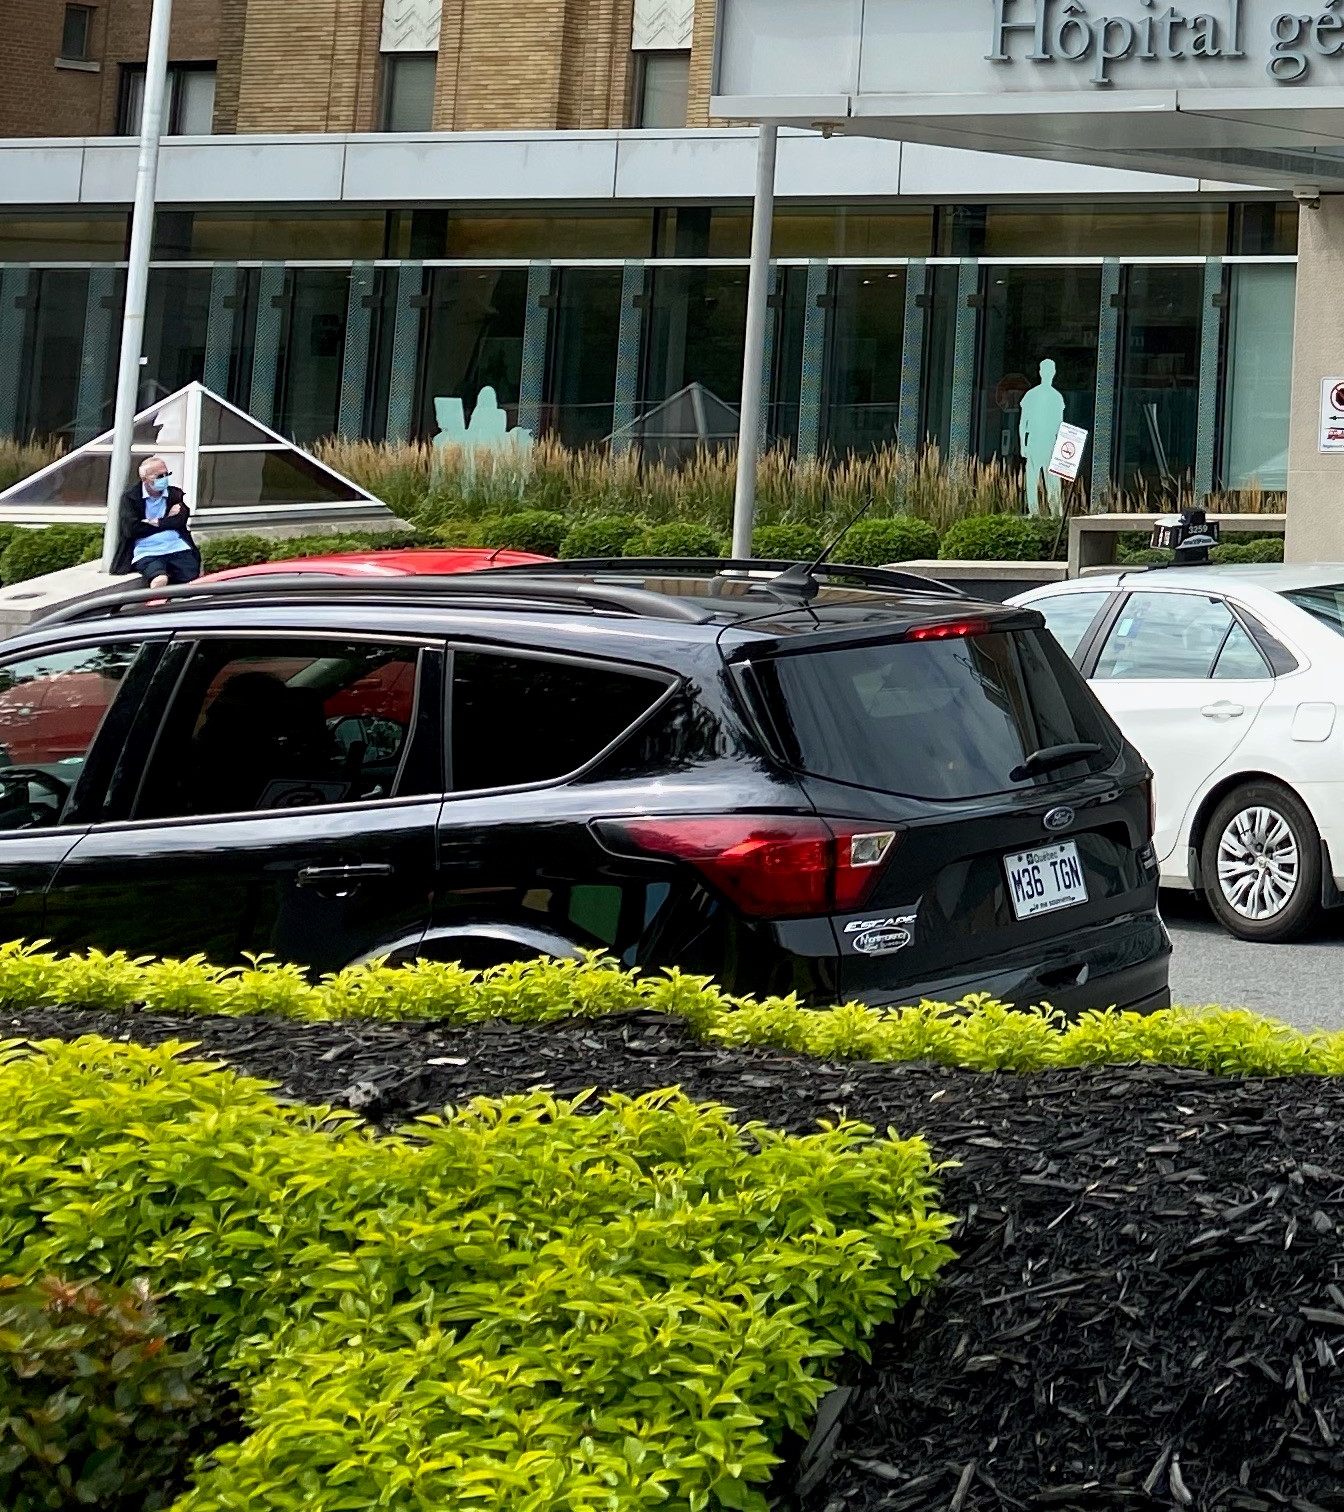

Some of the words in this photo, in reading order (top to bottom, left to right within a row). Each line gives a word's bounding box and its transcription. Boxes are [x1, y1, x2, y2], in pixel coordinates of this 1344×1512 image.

[1187, 523, 1209, 535] 3259
[1011, 864, 1045, 903] M36
[1050, 855, 1082, 892] TGN
[843, 914, 918, 933] ESCAPE
